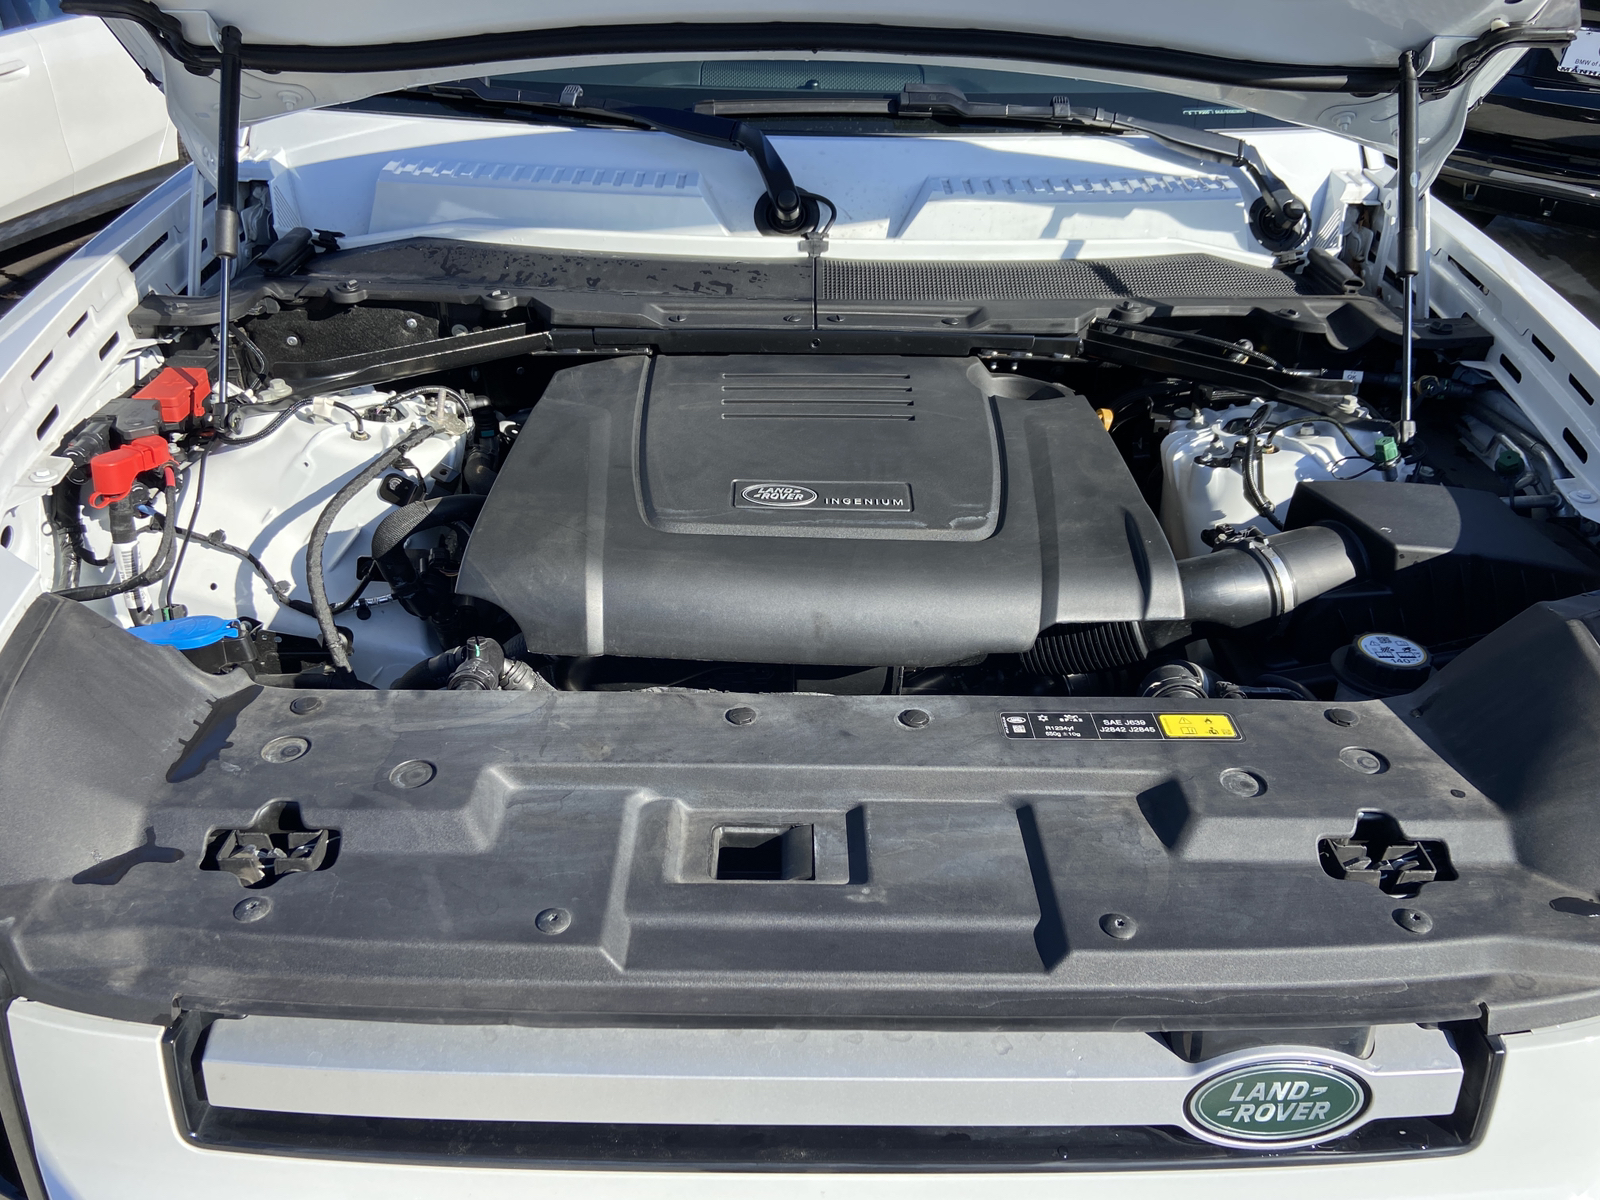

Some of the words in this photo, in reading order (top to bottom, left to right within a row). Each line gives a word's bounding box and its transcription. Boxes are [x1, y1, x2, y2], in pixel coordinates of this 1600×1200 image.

[1574, 58, 1591, 66] BMW
[1560, 65, 1600, 77] MANH
[761, 493, 803, 501] ROVER
[825, 497, 904, 506] INGENIUM
[1229, 1081, 1310, 1102] LAND
[1232, 1101, 1331, 1123] ROVER
